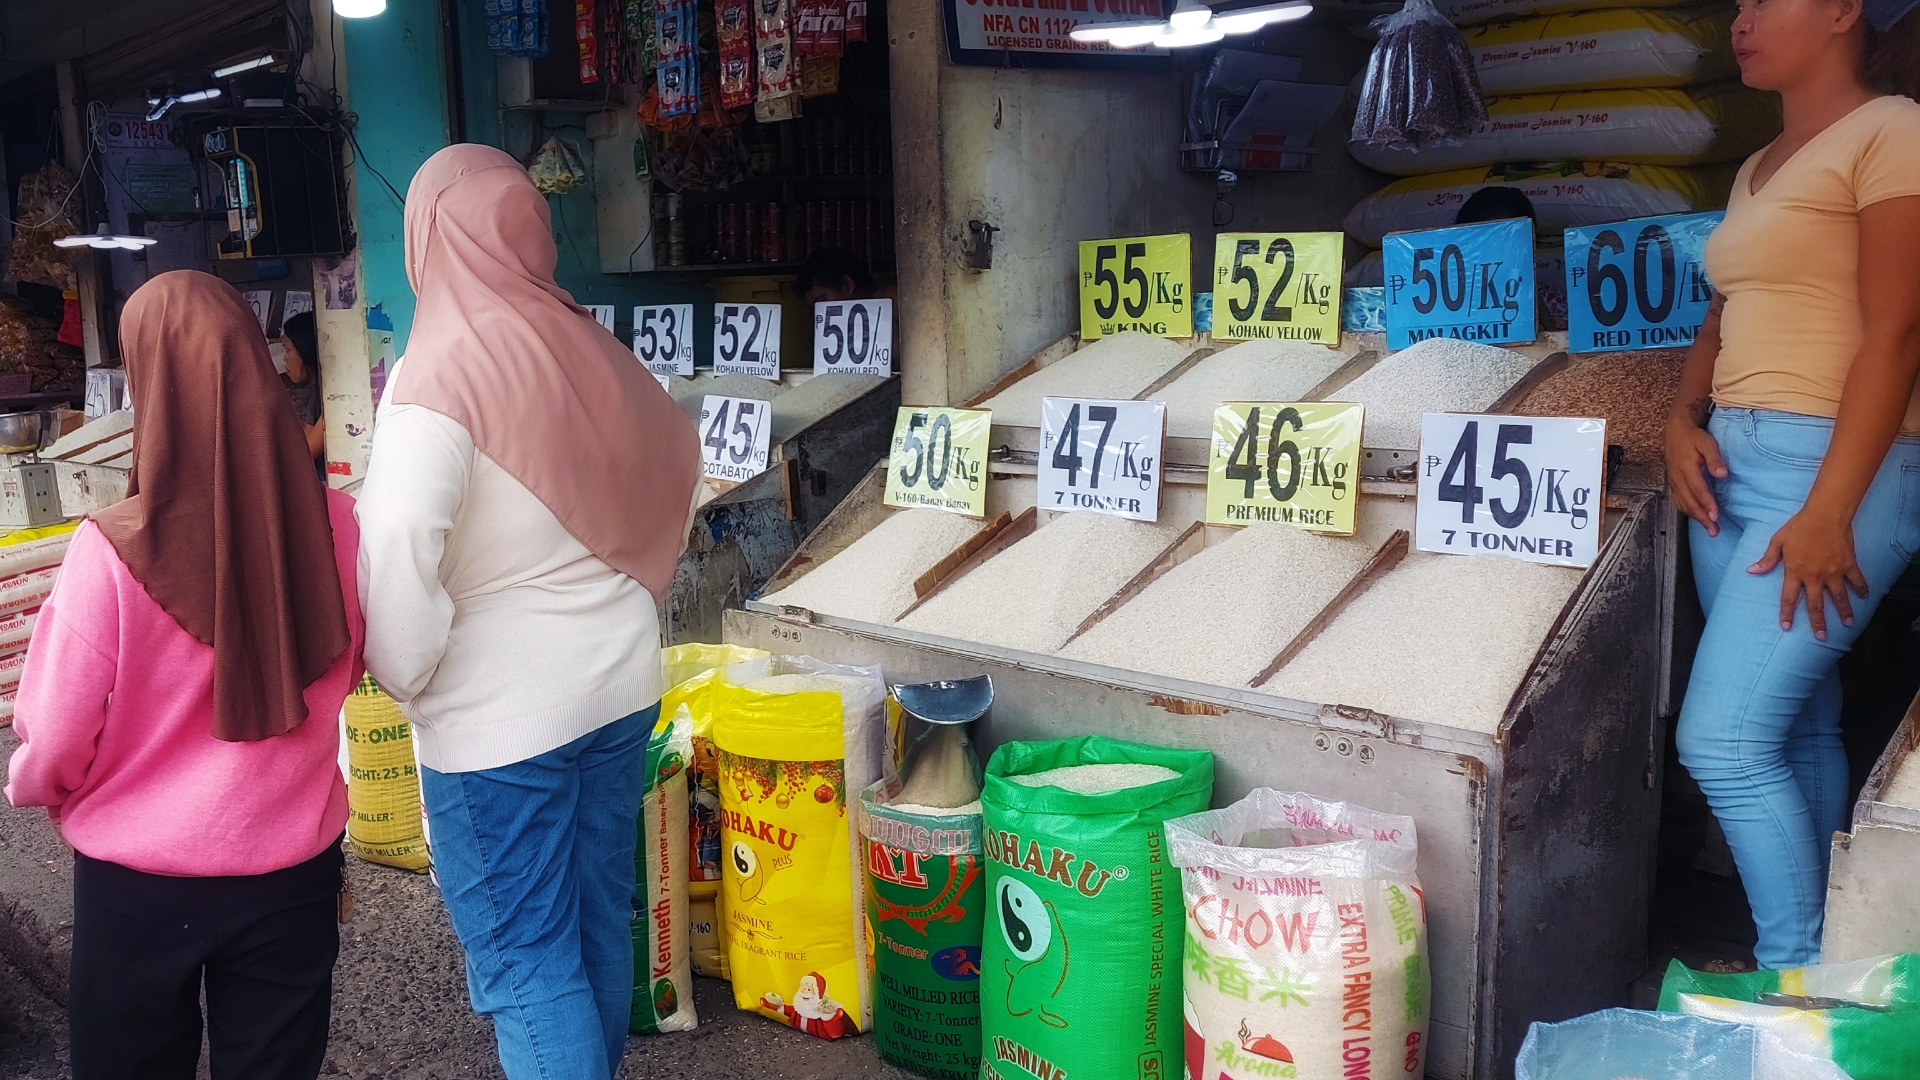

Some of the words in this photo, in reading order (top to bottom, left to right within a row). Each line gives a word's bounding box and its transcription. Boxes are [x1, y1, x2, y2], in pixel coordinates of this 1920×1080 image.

[983, 14, 1014, 34] NFA
[1018, 16, 1040, 35] CN
[987, 35, 1043, 49] LICENSED
[1046, 38, 1088, 51] GRAINS
[1566, 39, 1597, 53] V-160
[1577, 113, 1608, 126] V-160
[1552, 185, 1584, 197] V-160
[1228, 324, 1273, 339] KOHAKU
[1277, 326, 1322, 341] YELLOW
[1408, 322, 1512, 346] MALAGKIT
[1593, 329, 1631, 348] RED
[1637, 325, 1701, 346] TONNE
[1054, 491, 1065, 504] 7
[1071, 493, 1141, 513] TONNER
[1226, 504, 1293, 523] PREMIUM
[1300, 508, 1335, 526] RICE
[1441, 529, 1457, 546] 7
[1467, 531, 1574, 558] TONNER
[369, 723, 409, 744] ONE
[350, 764, 381, 781] EIGHT:
[384, 766, 398, 780] 25
[720, 807, 798, 851] OHAKU
[1148, 829, 1161, 864] RICE
[660, 838, 672, 895] 7-Tonner
[772, 854, 793, 870] PLUS
[1151, 867, 1163, 918] WHITE
[733, 910, 774, 932] JASMINE
[1193, 894, 1320, 955] CHOW
[1383, 885, 1418, 946] PRIME
[653, 898, 672, 979] Kenneth
[1151, 921, 1164, 978] SPECIAL
[1337, 902, 1371, 969] EXTRA
[741, 941, 782, 959] FRAGRANT
[784, 952, 807, 961] RICE
[880, 971, 902, 994] WELL
[902, 984, 946, 1004] MILLED
[950, 991, 980, 1005] RICE
[1343, 971, 1372, 1031] FANCY
[882, 993, 923, 1022] VARIETY:
[1145, 982, 1161, 1047] JASMINE
[893, 1020, 933, 1043] GRADE:
[935, 1033, 962, 1047] ONE
[884, 1032, 899, 1050] Net
[946, 1053, 960, 1065] 25
[1215, 1041, 1298, 1079] Aroma
